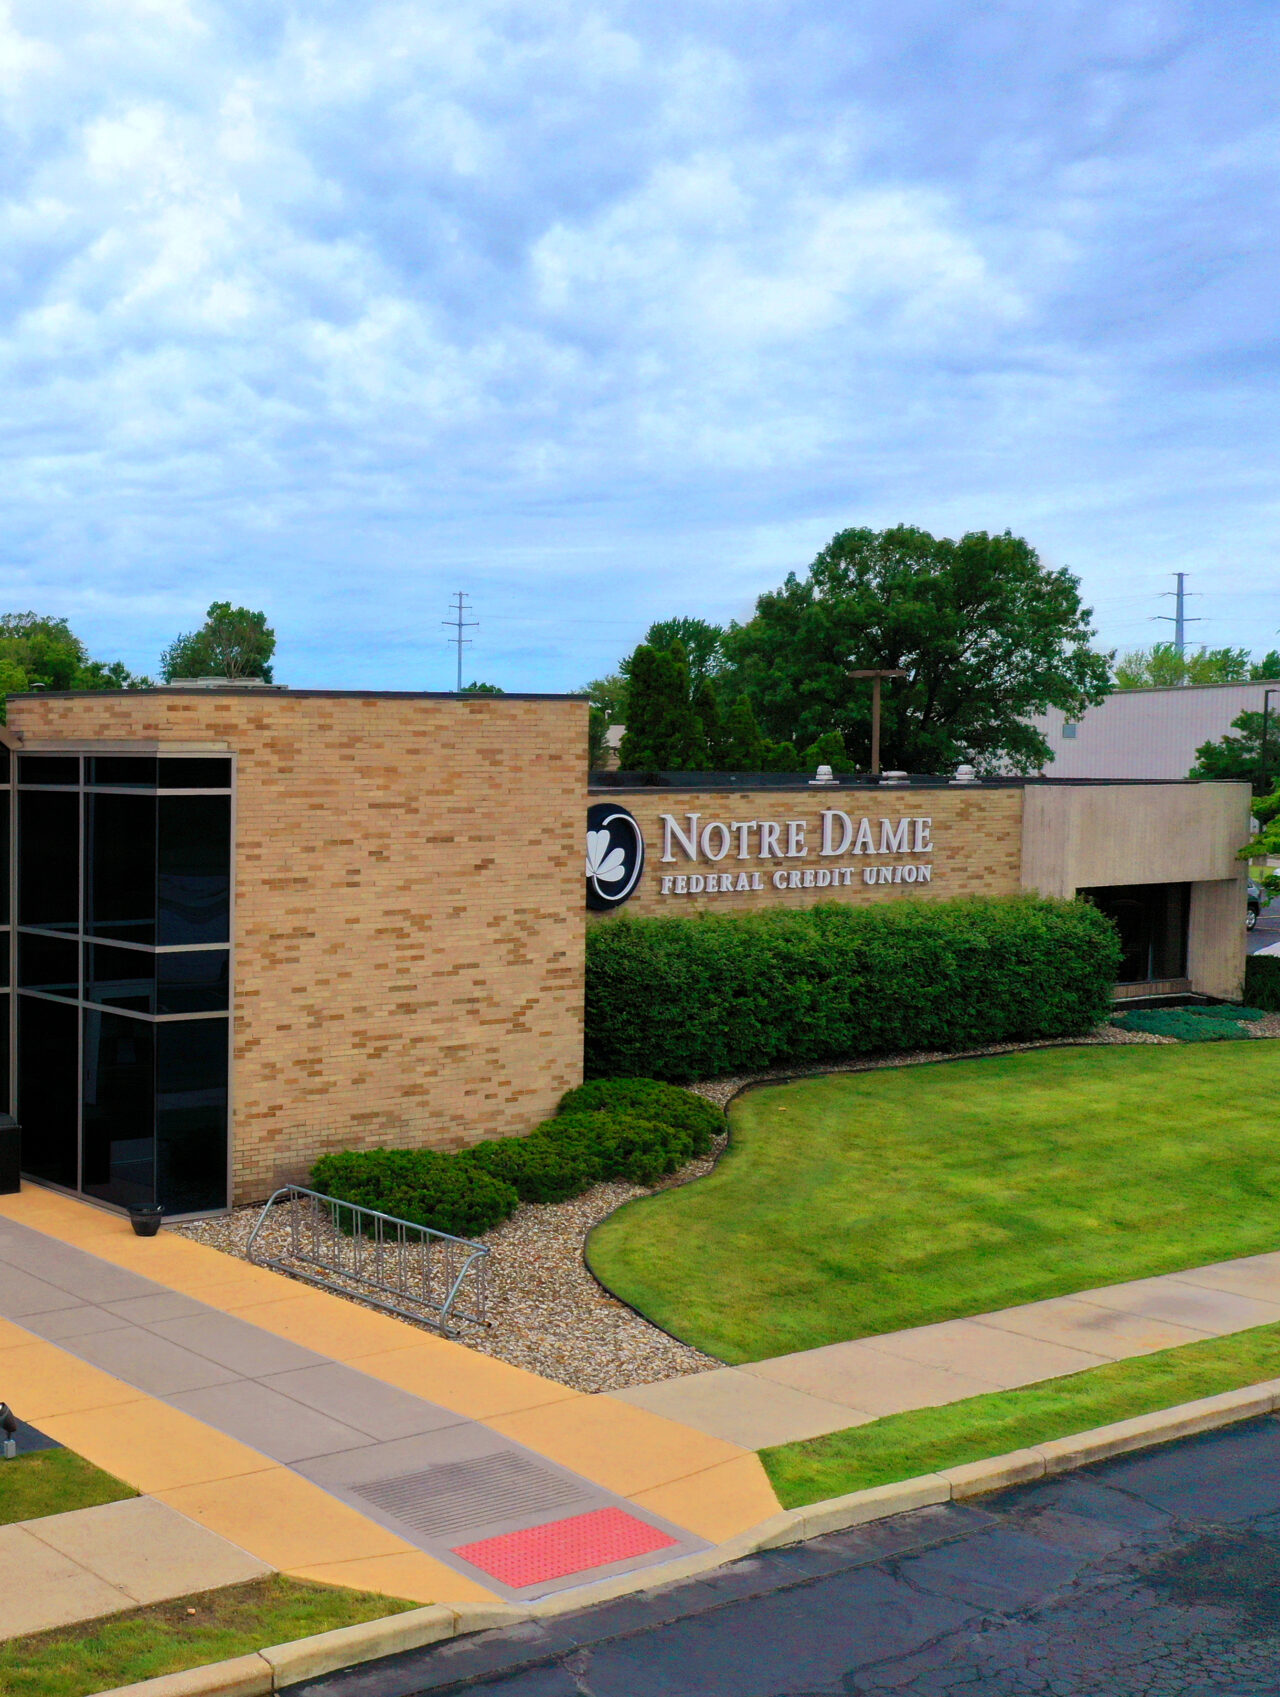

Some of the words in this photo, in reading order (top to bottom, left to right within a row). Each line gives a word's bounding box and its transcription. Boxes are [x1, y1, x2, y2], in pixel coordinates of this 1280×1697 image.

[659, 813, 808, 862] NOTRE
[819, 810, 933, 855] DAME
[661, 872, 764, 894] FEDERAL
[773, 868, 854, 889] CREDIT
[863, 865, 932, 885] UNION
